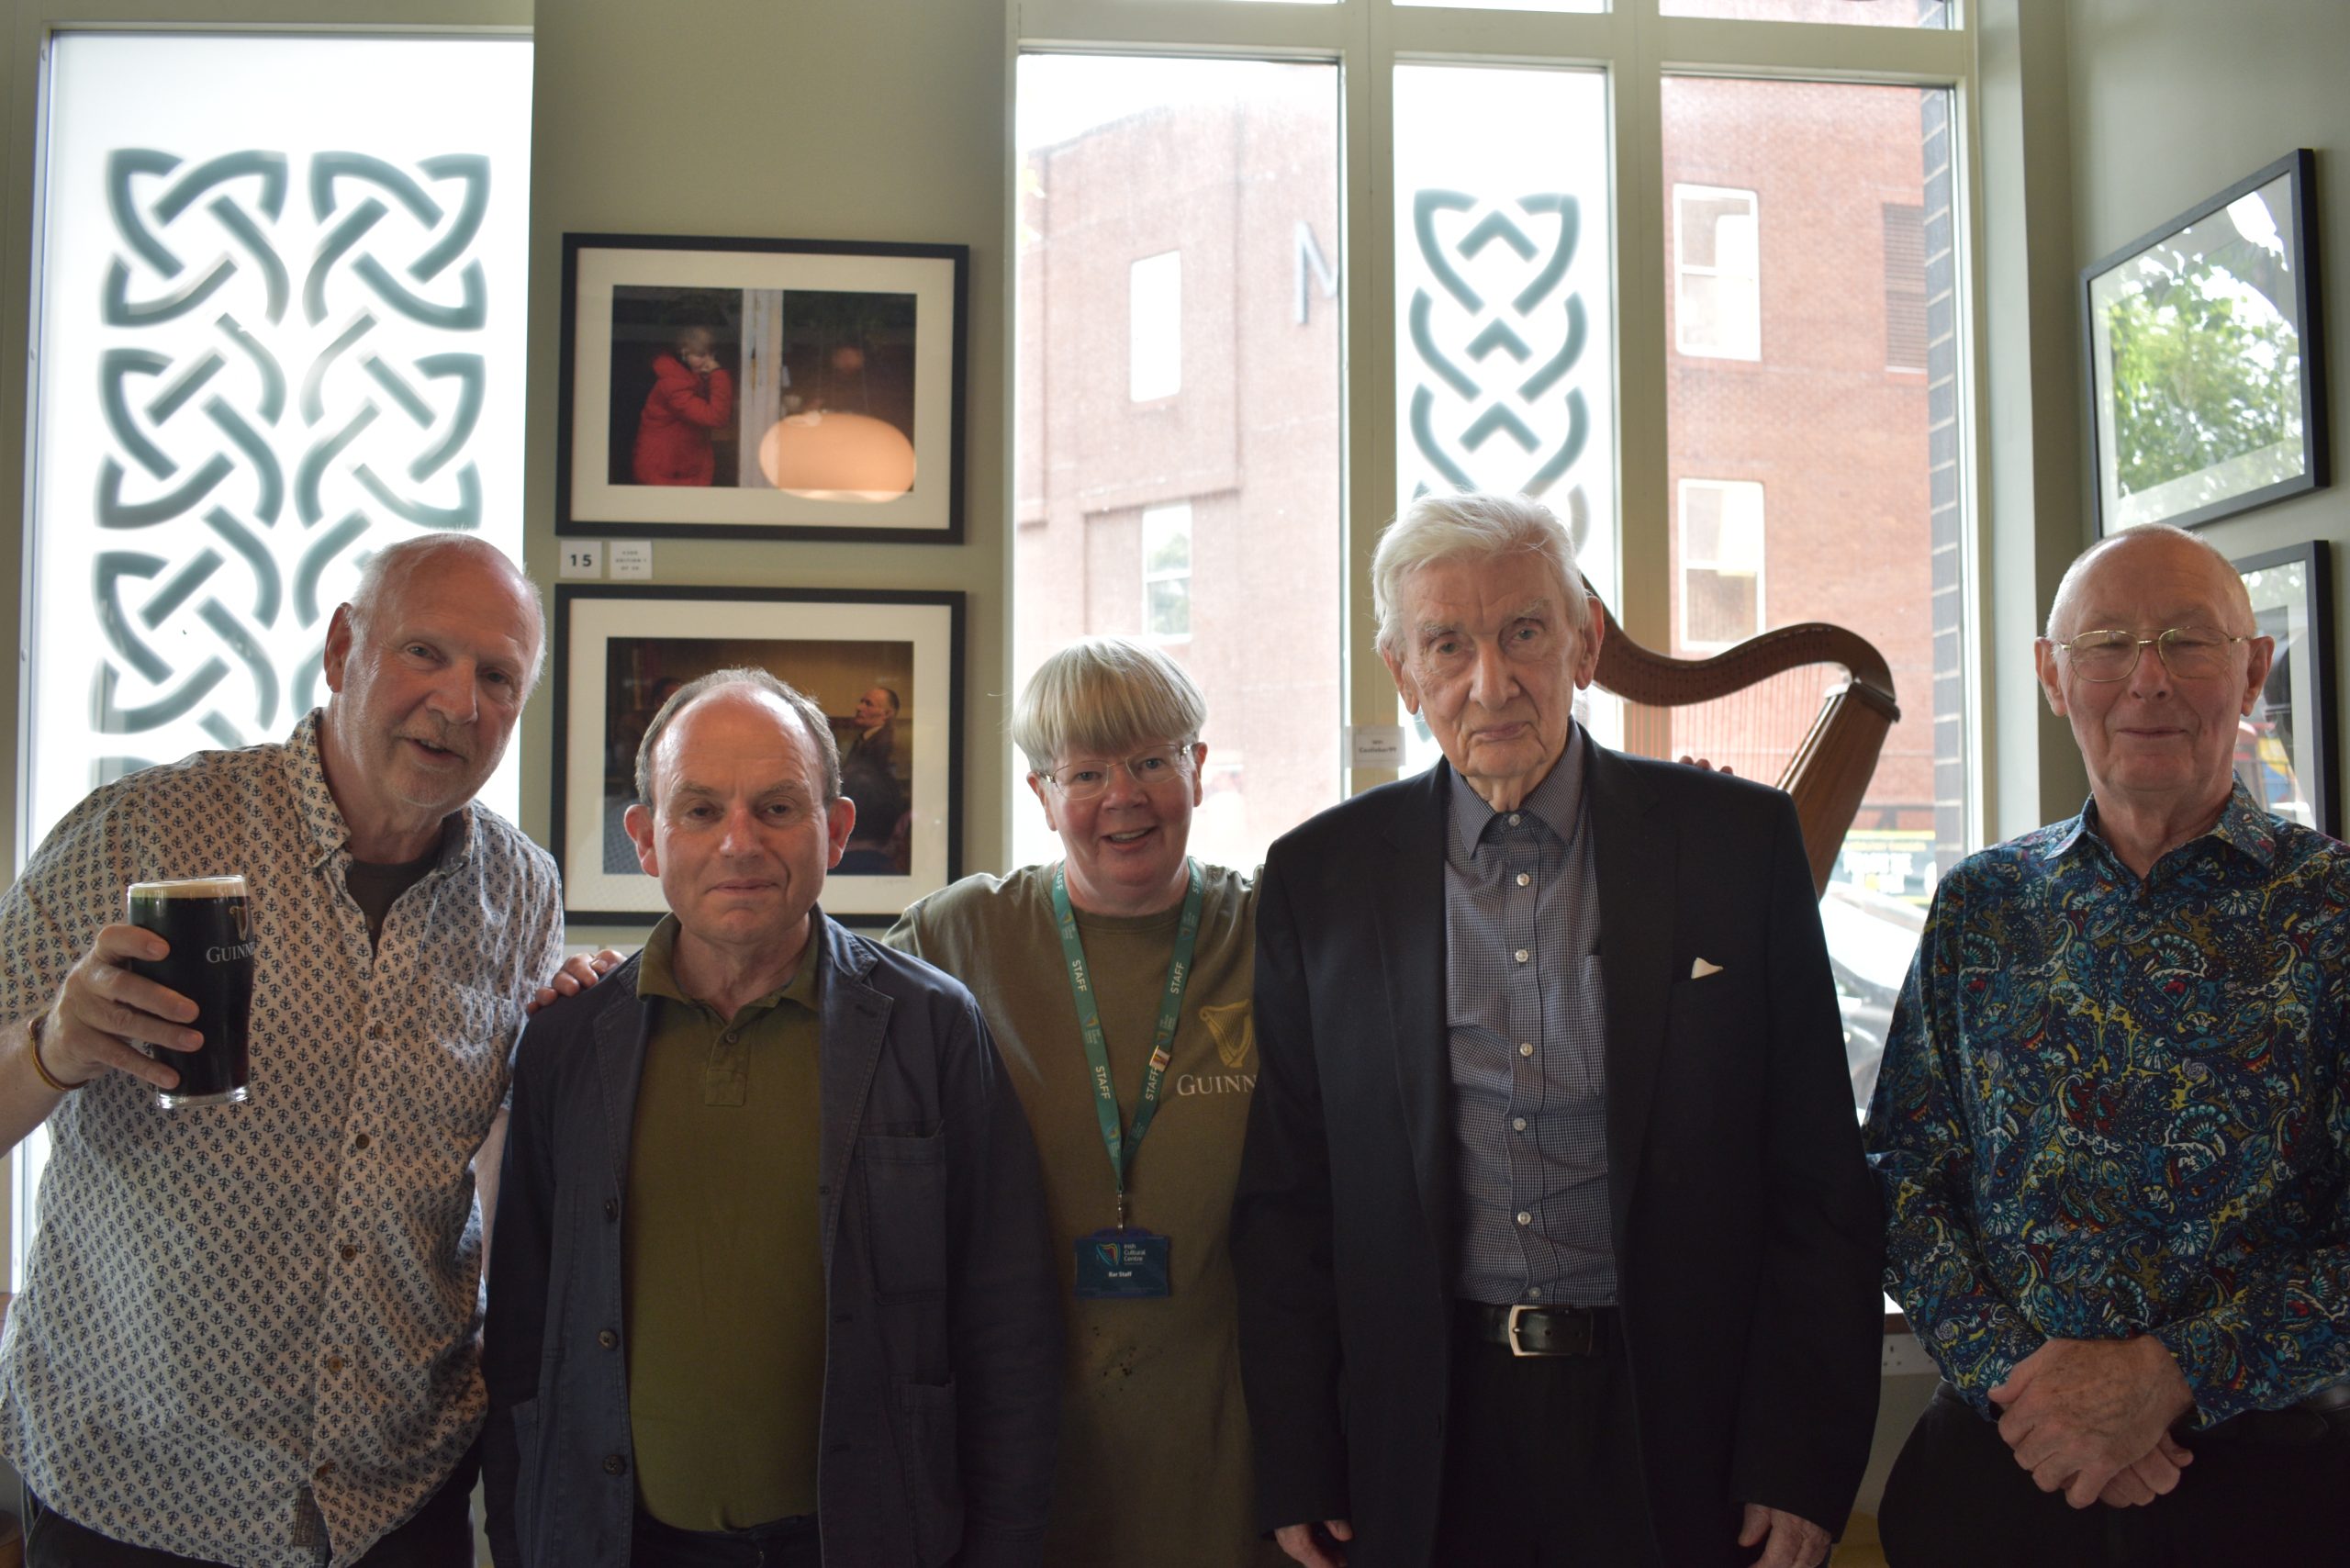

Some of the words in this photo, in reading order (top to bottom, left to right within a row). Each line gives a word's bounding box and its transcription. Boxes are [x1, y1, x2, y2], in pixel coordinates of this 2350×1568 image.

[570, 554, 592, 567] 15
[1072, 959, 1087, 992] STAFF
[1170, 961, 1185, 994] STAFF
[1095, 1065, 1111, 1100] STAFF
[1145, 1068, 1159, 1102] STAFF
